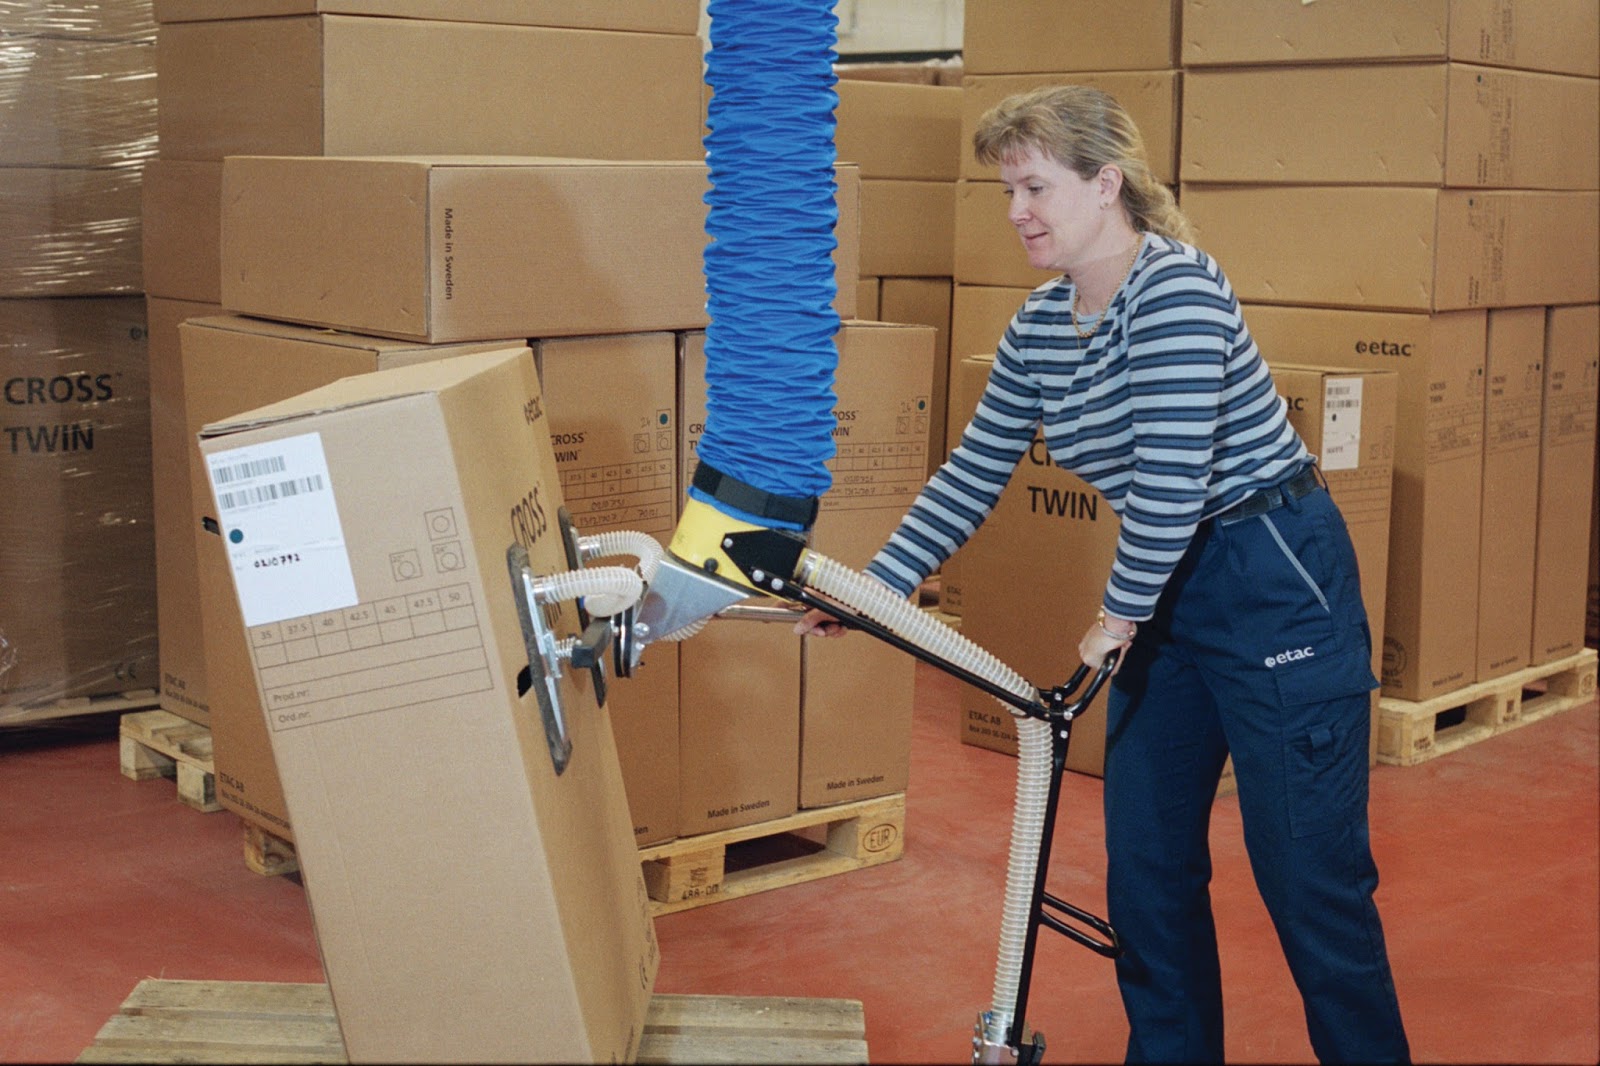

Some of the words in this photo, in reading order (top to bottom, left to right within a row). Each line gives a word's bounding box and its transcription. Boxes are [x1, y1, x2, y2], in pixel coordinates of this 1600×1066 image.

[444, 208, 453, 239] Made
[445, 242, 453, 253] in
[445, 256, 454, 300] Sweden
[3, 374, 113, 405] CROSS
[831, 410, 857, 421] ROSS
[3, 424, 94, 453] TWIN
[831, 427, 850, 437] WIN
[554, 451, 578, 463] WIN
[1027, 486, 1097, 521] TWIN
[510, 487, 547, 550] CROSS
[260, 631, 273, 641] 35
[288, 624, 307, 634] 37.5
[322, 618, 334, 627] 40
[350, 610, 369, 622] 42.5
[384, 605, 397, 614] 45
[414, 597, 433, 608] 47.5
[449, 592, 461, 601] 50
[826, 780, 846, 790] Made
[847, 779, 855, 788] in
[856, 775, 884, 786] Sweden
[707, 808, 729, 819] Made
[730, 806, 739, 815] in
[740, 800, 770, 813] Sweden
[870, 828, 890, 849] EUR
